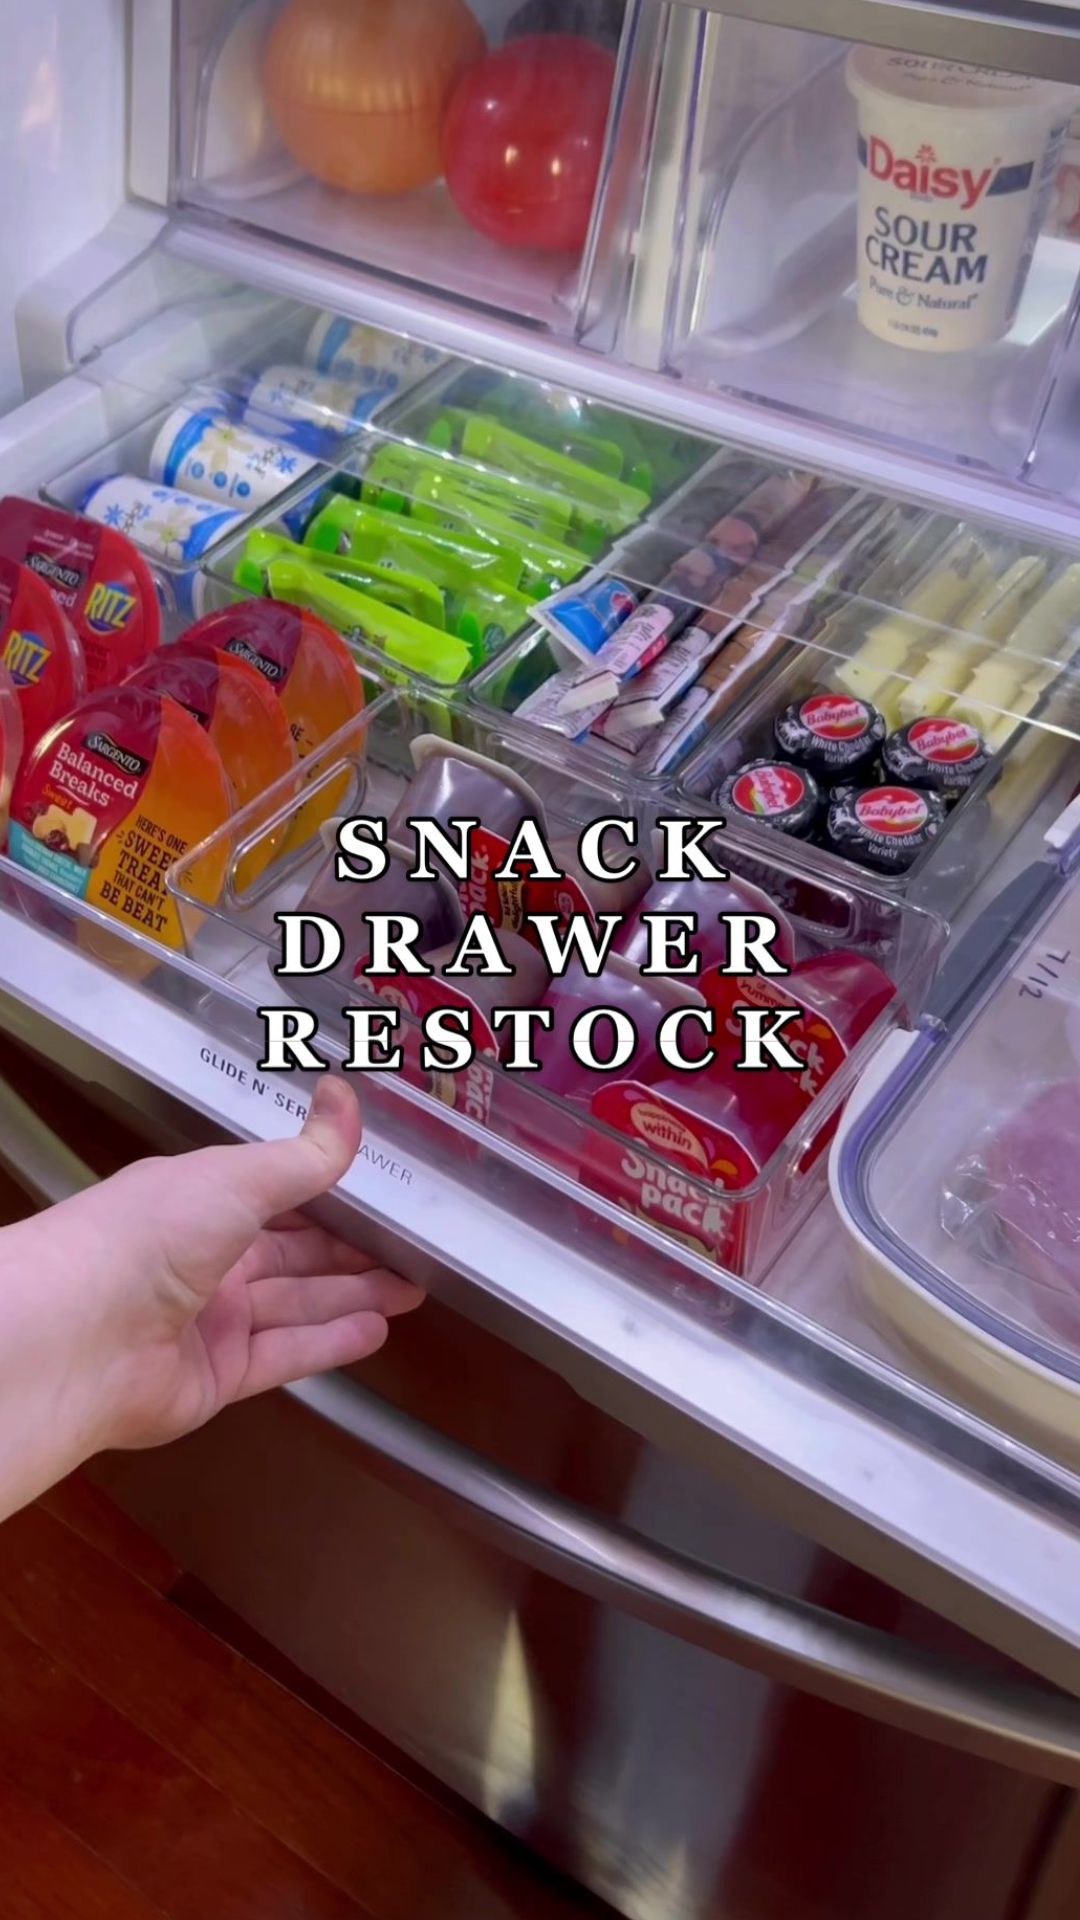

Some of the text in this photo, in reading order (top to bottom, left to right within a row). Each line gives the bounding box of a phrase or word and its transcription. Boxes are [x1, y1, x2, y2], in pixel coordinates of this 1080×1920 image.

[868, 134, 992, 210] Daisy
[875, 205, 977, 253] SOUR
[865, 234, 988, 285] CREAM
[869, 274, 894, 298] Pure
[84, 581, 137, 629] RITZ
[2, 629, 52, 684] RITZ
[228, 641, 281, 678] SARGENTO
[805, 703, 860, 725] Babybel
[87, 734, 142, 773] SARGENTO
[810, 736, 838, 751] White
[916, 727, 969, 750] Babybel
[49, 760, 111, 807] Breaks
[56, 742, 139, 799] Balanced
[927, 761, 955, 775] White
[858, 803, 922, 819] Babybel
[136, 814, 188, 856] HERE'S ONE
[857, 826, 923, 847] White Cheddar
[867, 842, 898, 859] Variety
[99, 881, 168, 933] BE BEAT
[113, 869, 166, 910] THAT CAN'T
[1018, 949, 1071, 999] 7/12
[199, 1047, 414, 1186] GLIDE N' SER AWER
[642, 1119, 693, 1150] within
[621, 1137, 734, 1215] Snack
[641, 1181, 727, 1239] pack
